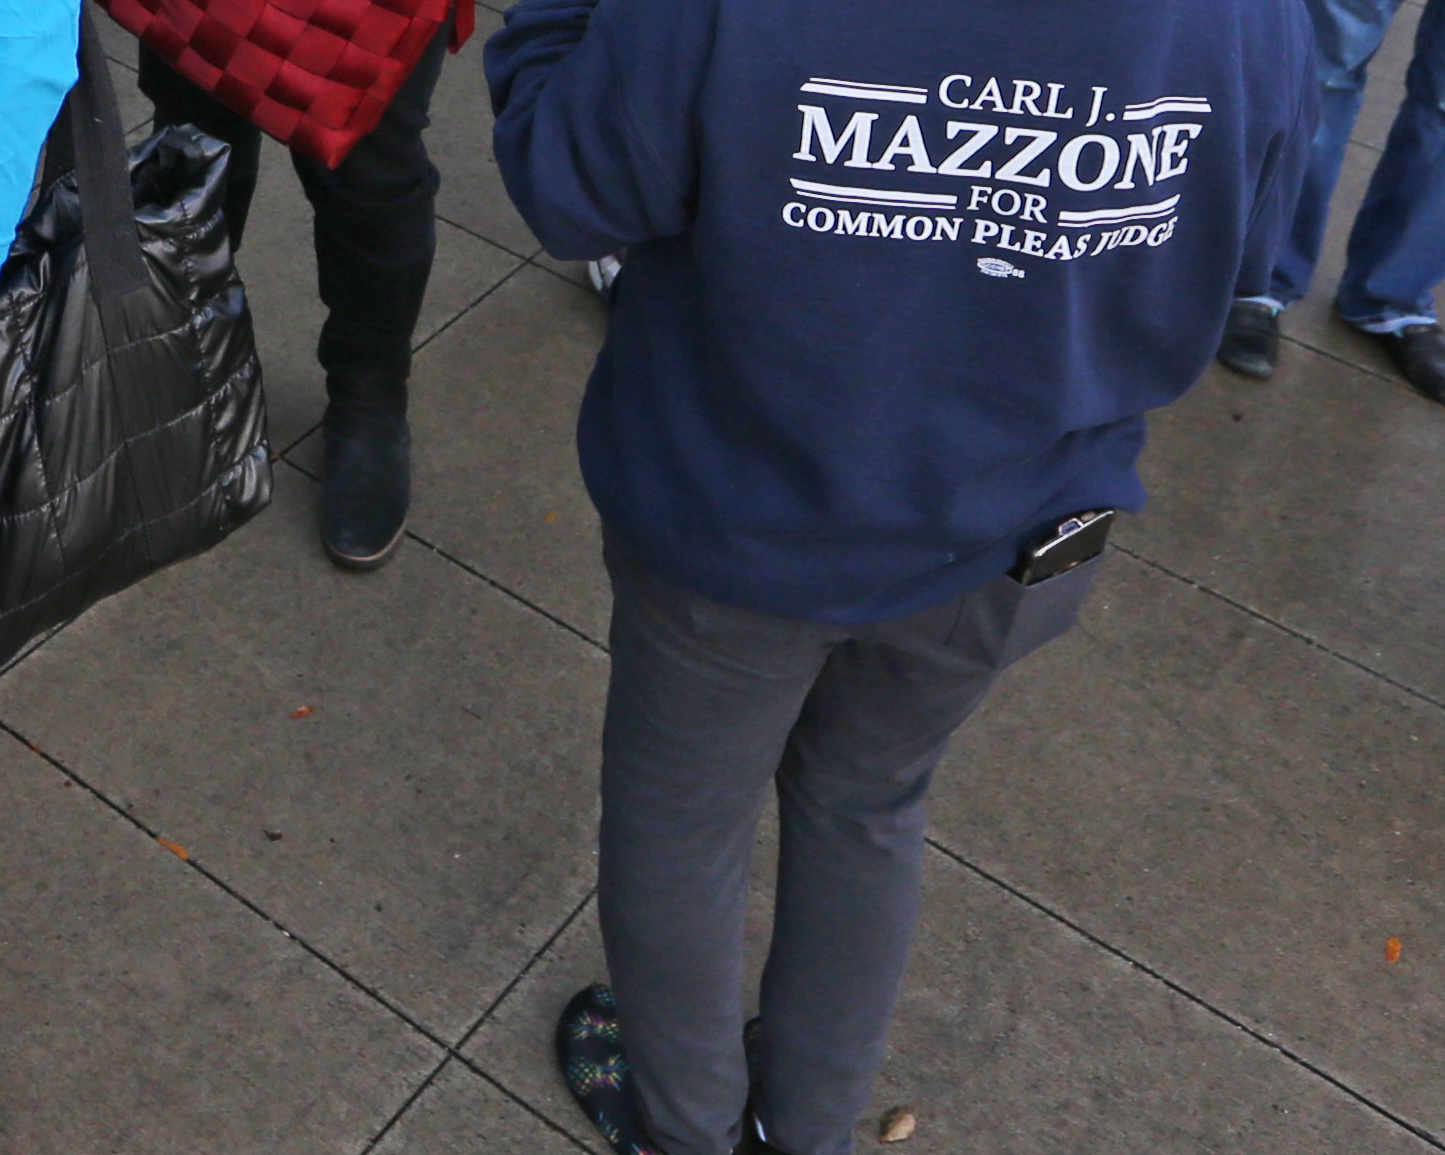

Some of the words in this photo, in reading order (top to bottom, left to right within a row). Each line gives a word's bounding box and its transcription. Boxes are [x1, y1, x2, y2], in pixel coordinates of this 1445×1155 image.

[937, 73, 1075, 121] CARL
[1085, 85, 1117, 128] J.
[792, 103, 1204, 192] MAZZONE
[781, 200, 964, 245] COMMON
[970, 218, 1092, 262] PLEAS
[1090, 216, 1179, 258] JUDGE
[966, 185, 1049, 225] FOR
